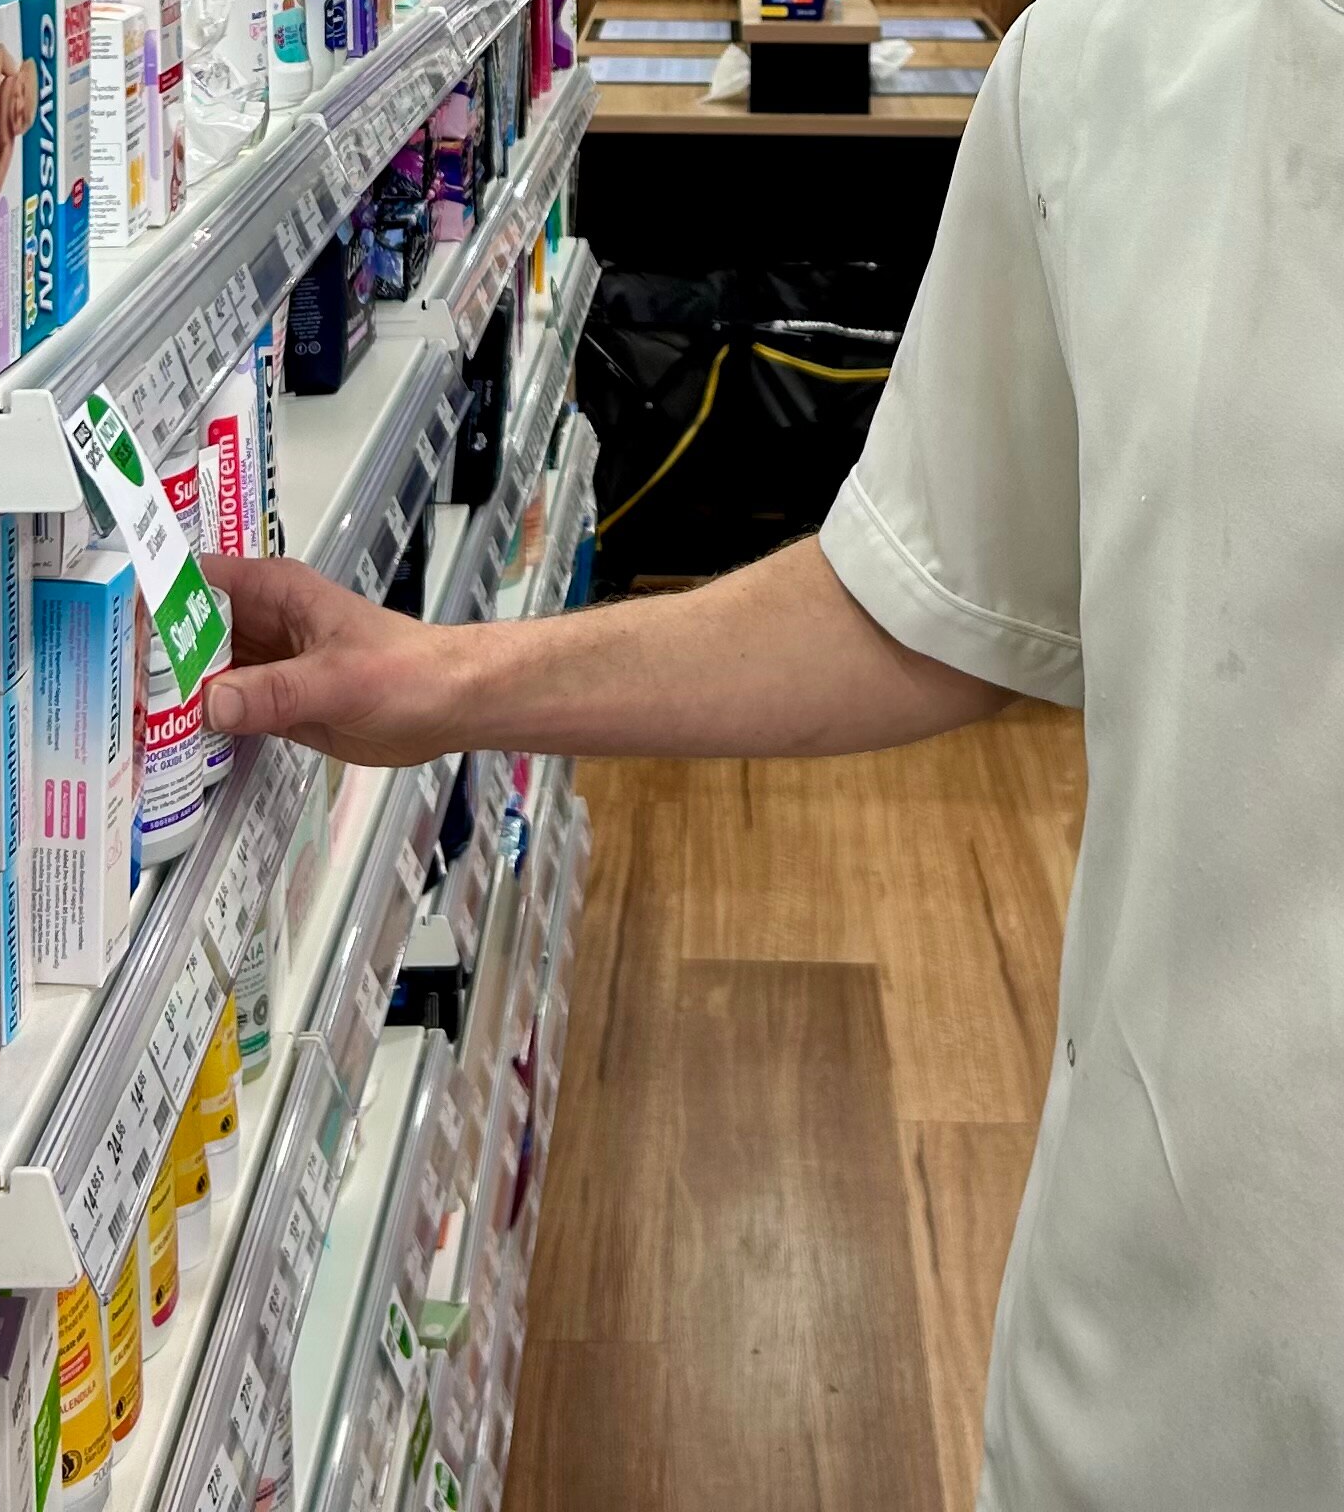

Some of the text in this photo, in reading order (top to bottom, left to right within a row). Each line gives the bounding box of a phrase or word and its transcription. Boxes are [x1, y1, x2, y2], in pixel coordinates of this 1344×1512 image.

[38, 13, 55, 312] GAVISCON
[5, 524, 19, 682] Bepanthen
[106, 595, 121, 764] Bepanthen
[186, 588, 213, 631] Wise
[6, 705, 20, 859] Bepanthen
[146, 700, 202, 744] udocre
[7, 879, 20, 1034] Bepanthen
